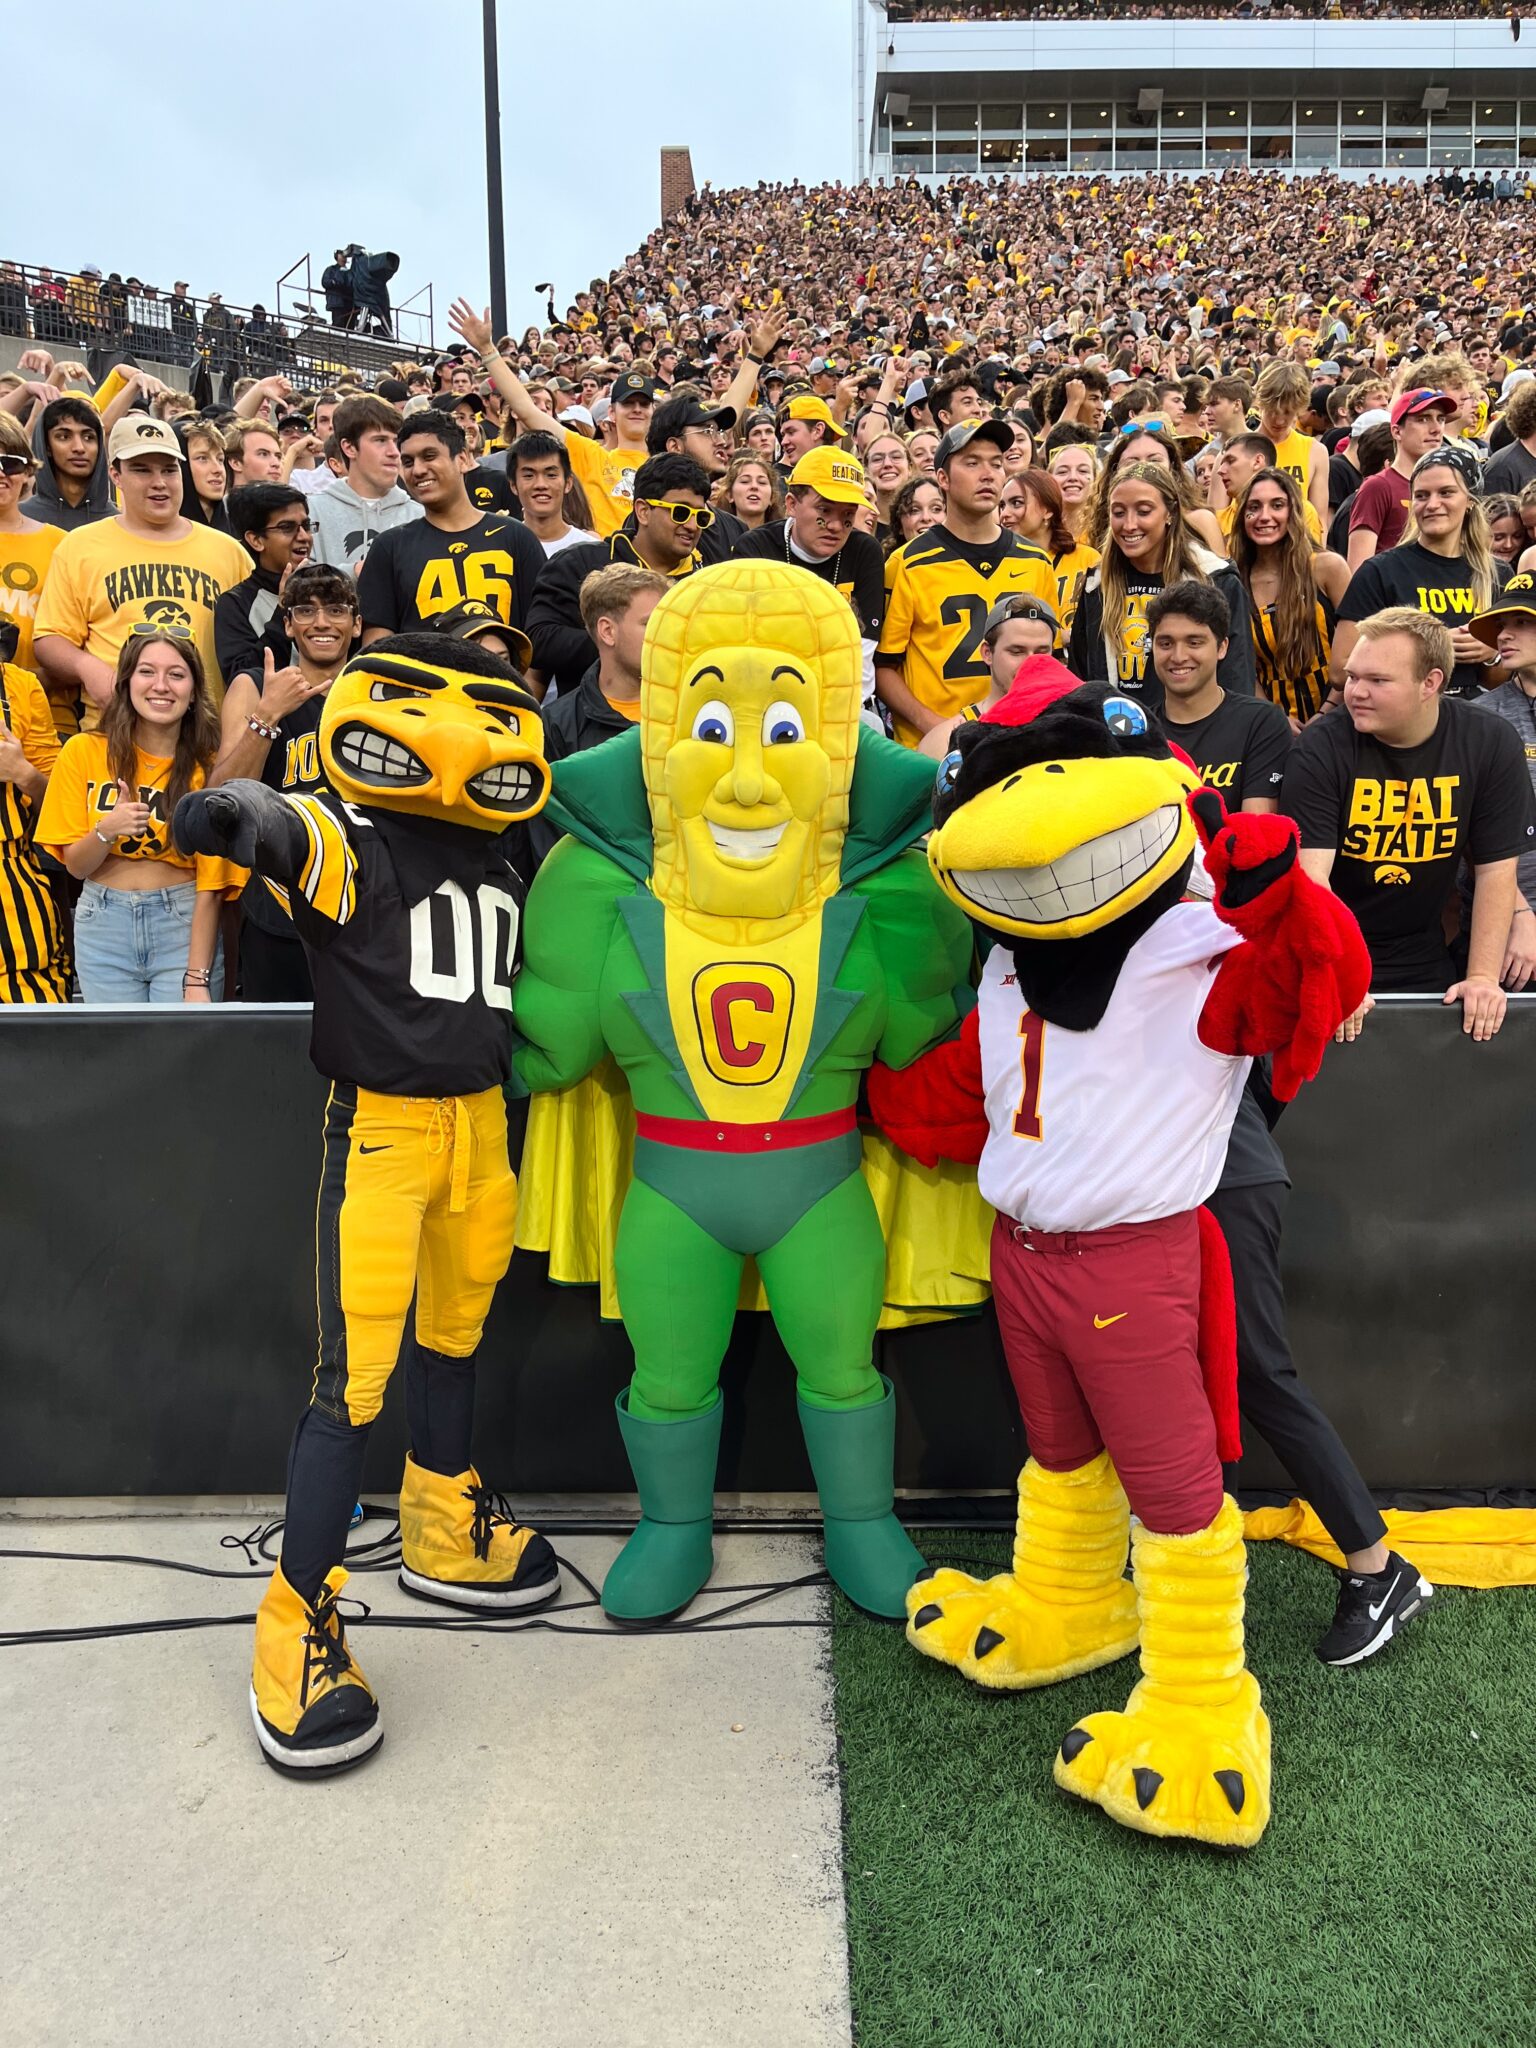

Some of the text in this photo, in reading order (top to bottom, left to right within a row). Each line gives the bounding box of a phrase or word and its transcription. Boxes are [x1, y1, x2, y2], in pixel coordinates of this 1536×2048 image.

[832, 465, 849, 479] BEAT
[104, 563, 221, 613] HAWKEYES
[415, 549, 513, 626] 46
[940, 592, 1020, 680] 2
[1349, 775, 1460, 824] BEAT
[1341, 821, 1458, 860] STATE
[409, 878, 520, 1013] 00
[710, 981, 775, 1068] C
[1011, 1007, 1046, 1143] 1
